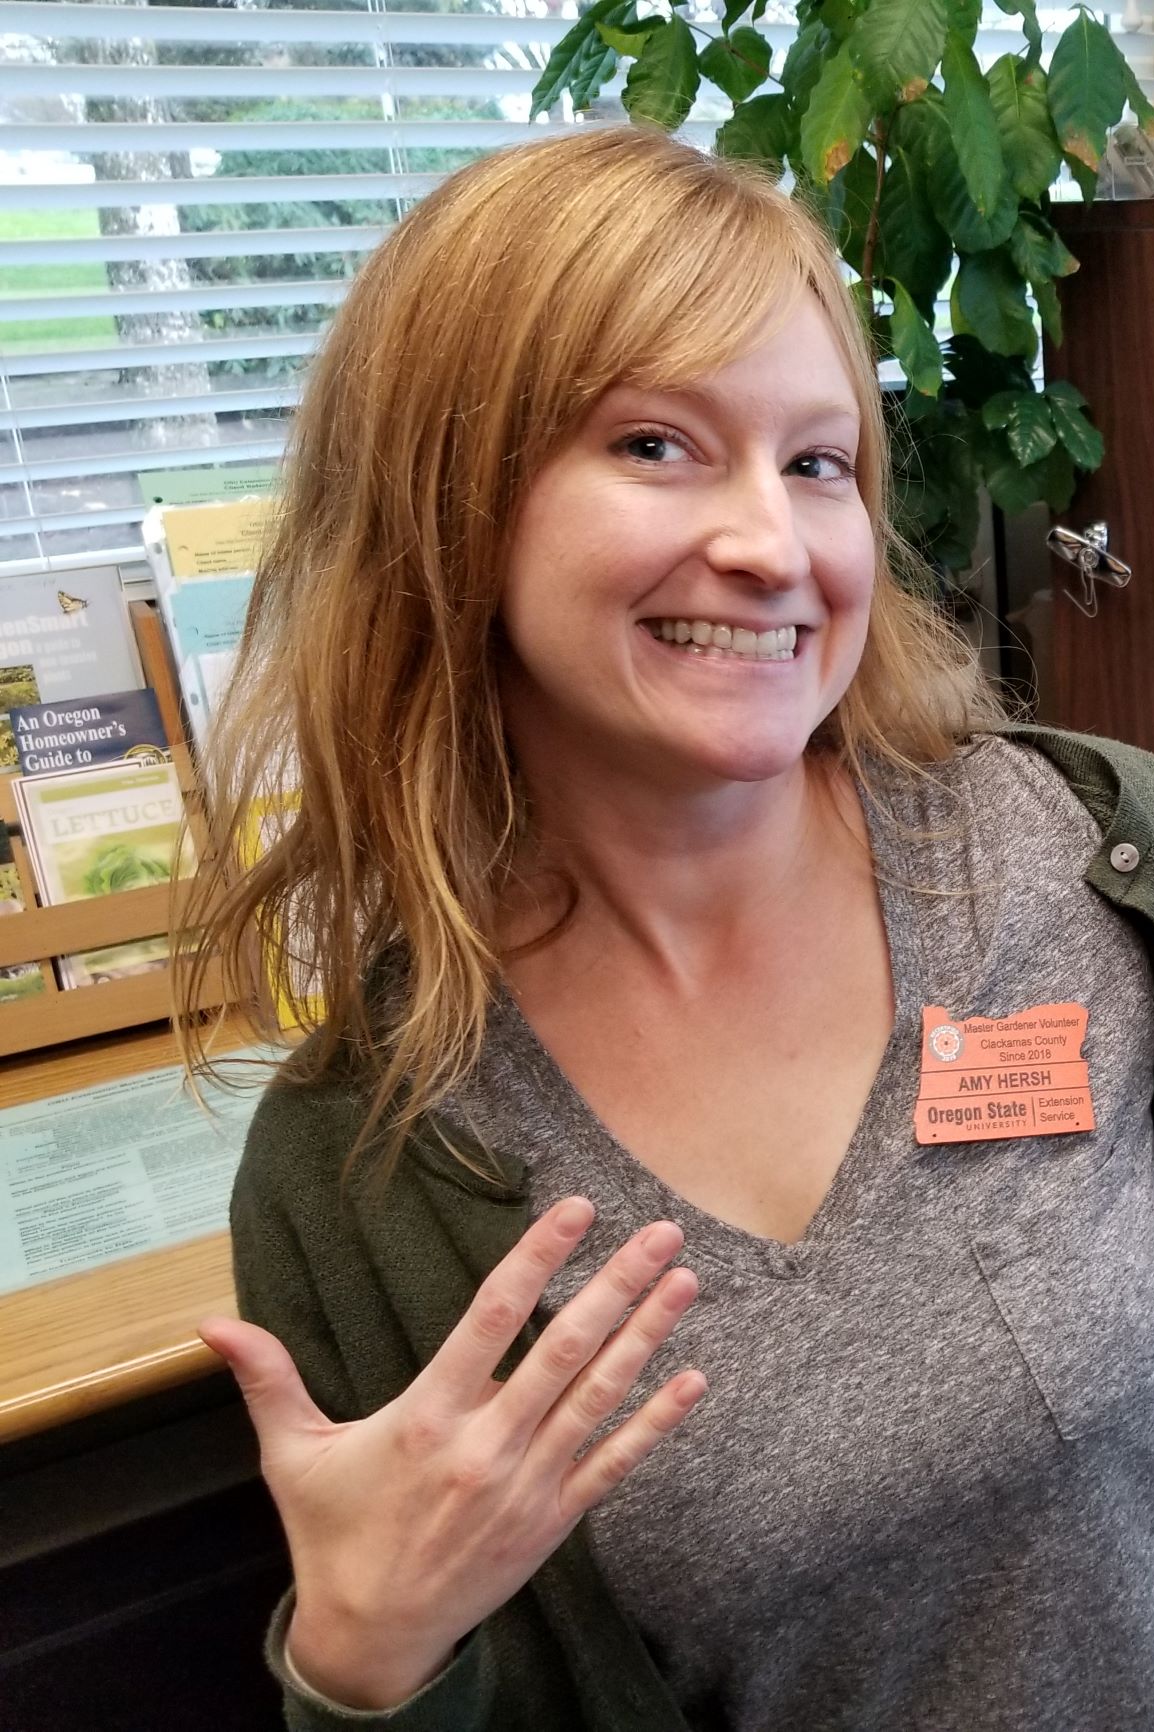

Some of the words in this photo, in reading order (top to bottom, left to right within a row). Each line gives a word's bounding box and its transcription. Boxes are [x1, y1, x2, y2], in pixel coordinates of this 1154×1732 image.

[16, 711, 40, 732] An
[43, 705, 102, 733] Oregon
[21, 721, 127, 752] Homeowner's
[25, 750, 67, 774] Guide
[72, 749, 93, 766] to
[51, 798, 175, 839] LETTUCE
[964, 1022, 994, 1034] Master
[996, 1019, 1037, 1032] Gardener
[1039, 1018, 1080, 1028] Volunteer
[981, 1037, 1032, 1050] Clackamas
[1034, 1035, 1067, 1048] County
[999, 1051, 1027, 1062] Since
[1028, 1049, 1052, 1060] 2018
[959, 1074, 994, 1092] AMY
[998, 1071, 1052, 1090] HERSH
[1039, 1096, 1084, 1108] Extension
[928, 1104, 982, 1125] Oregon
[987, 1101, 1028, 1118] State
[1040, 1111, 1075, 1122] Service
[966, 1119, 1028, 1131] UNIVERSITY
